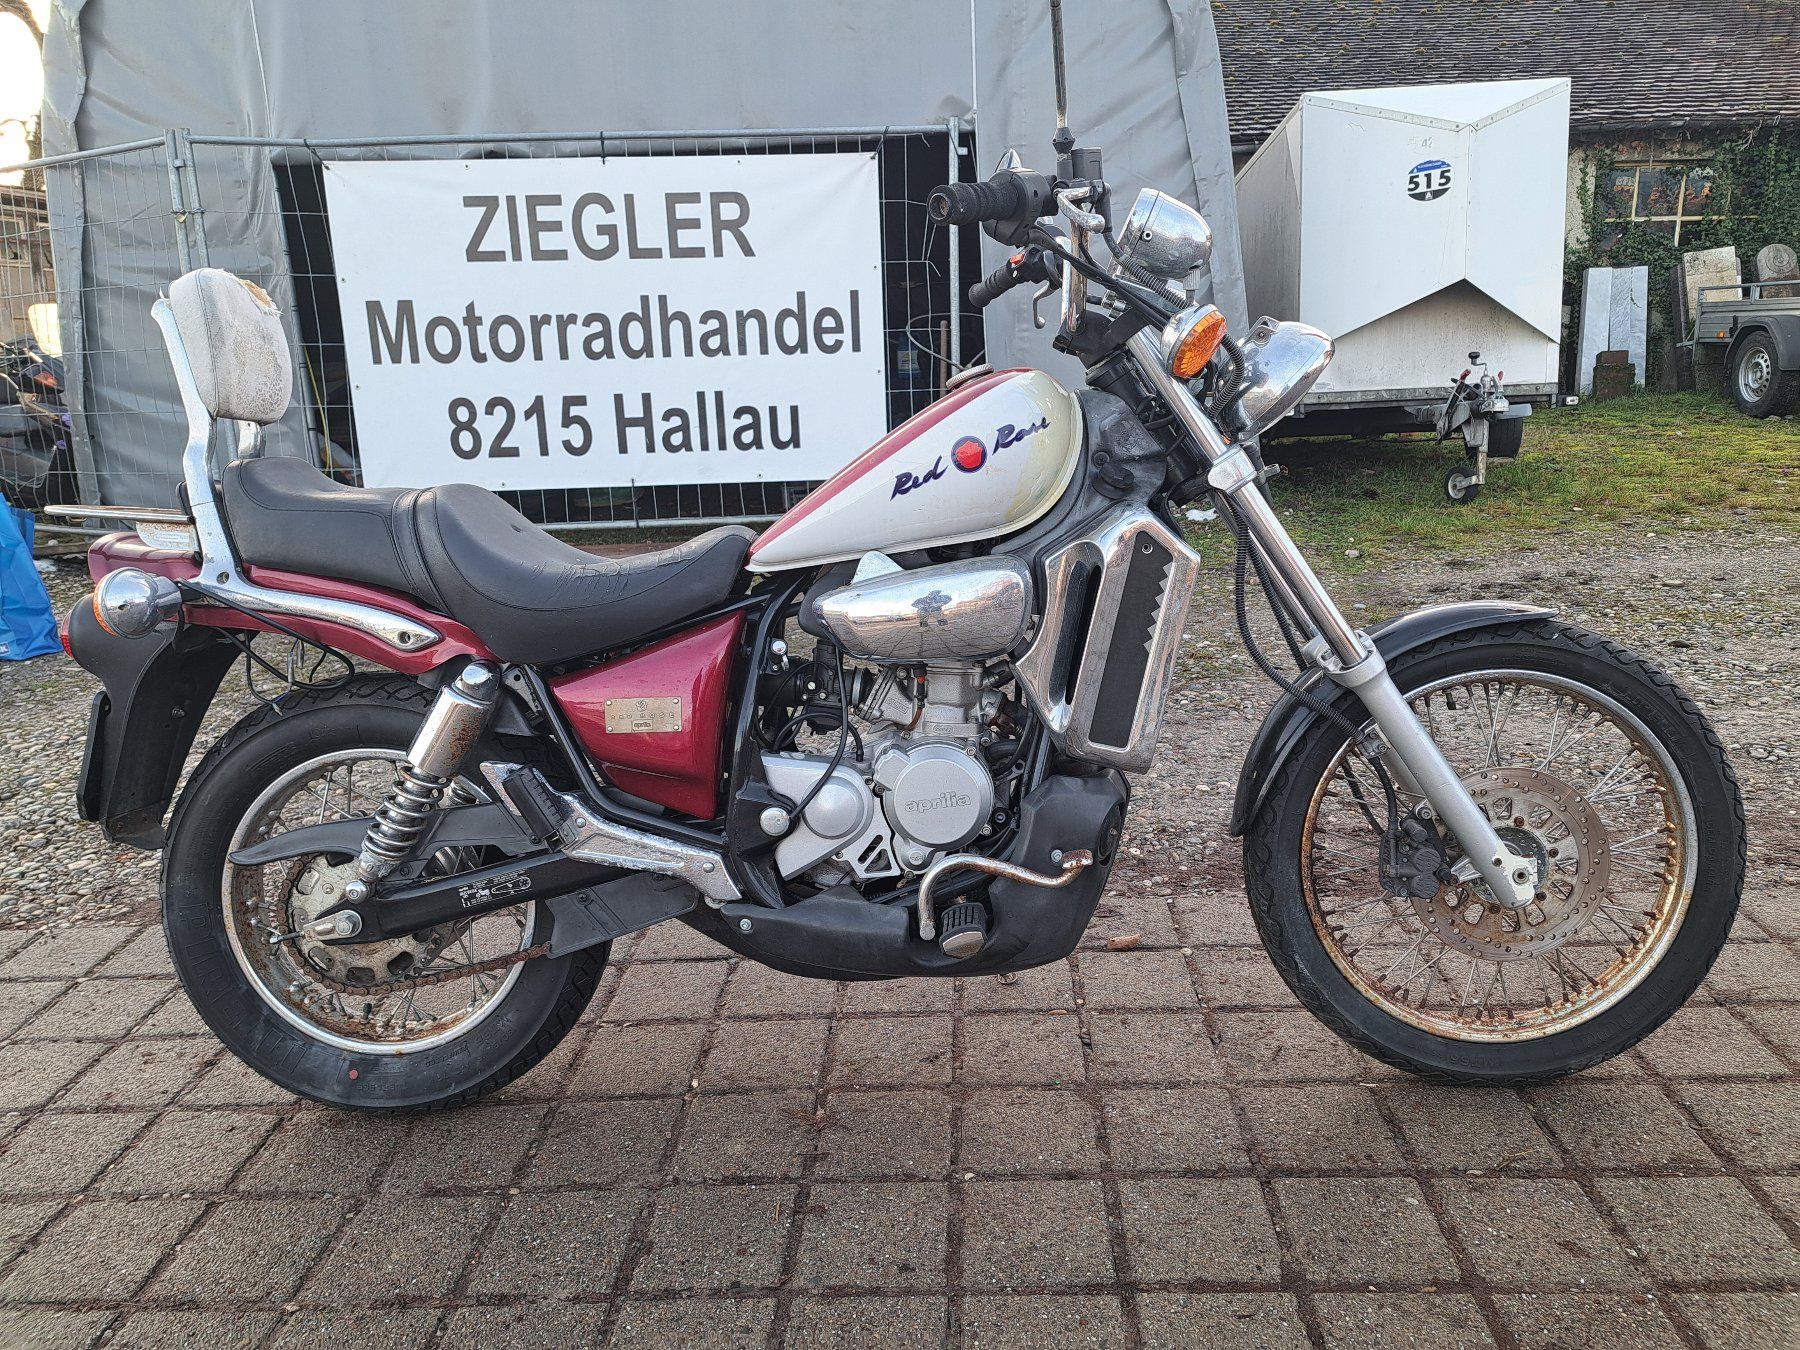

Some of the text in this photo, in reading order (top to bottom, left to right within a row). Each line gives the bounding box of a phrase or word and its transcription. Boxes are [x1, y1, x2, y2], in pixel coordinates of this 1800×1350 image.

[1407, 168, 1451, 192] 515
[463, 191, 756, 262] ZIEGLER
[366, 289, 860, 365] Motorradhandel
[449, 390, 800, 460] 8215 Hallau
[889, 455, 948, 501] Red
[905, 791, 971, 813] aprilia
